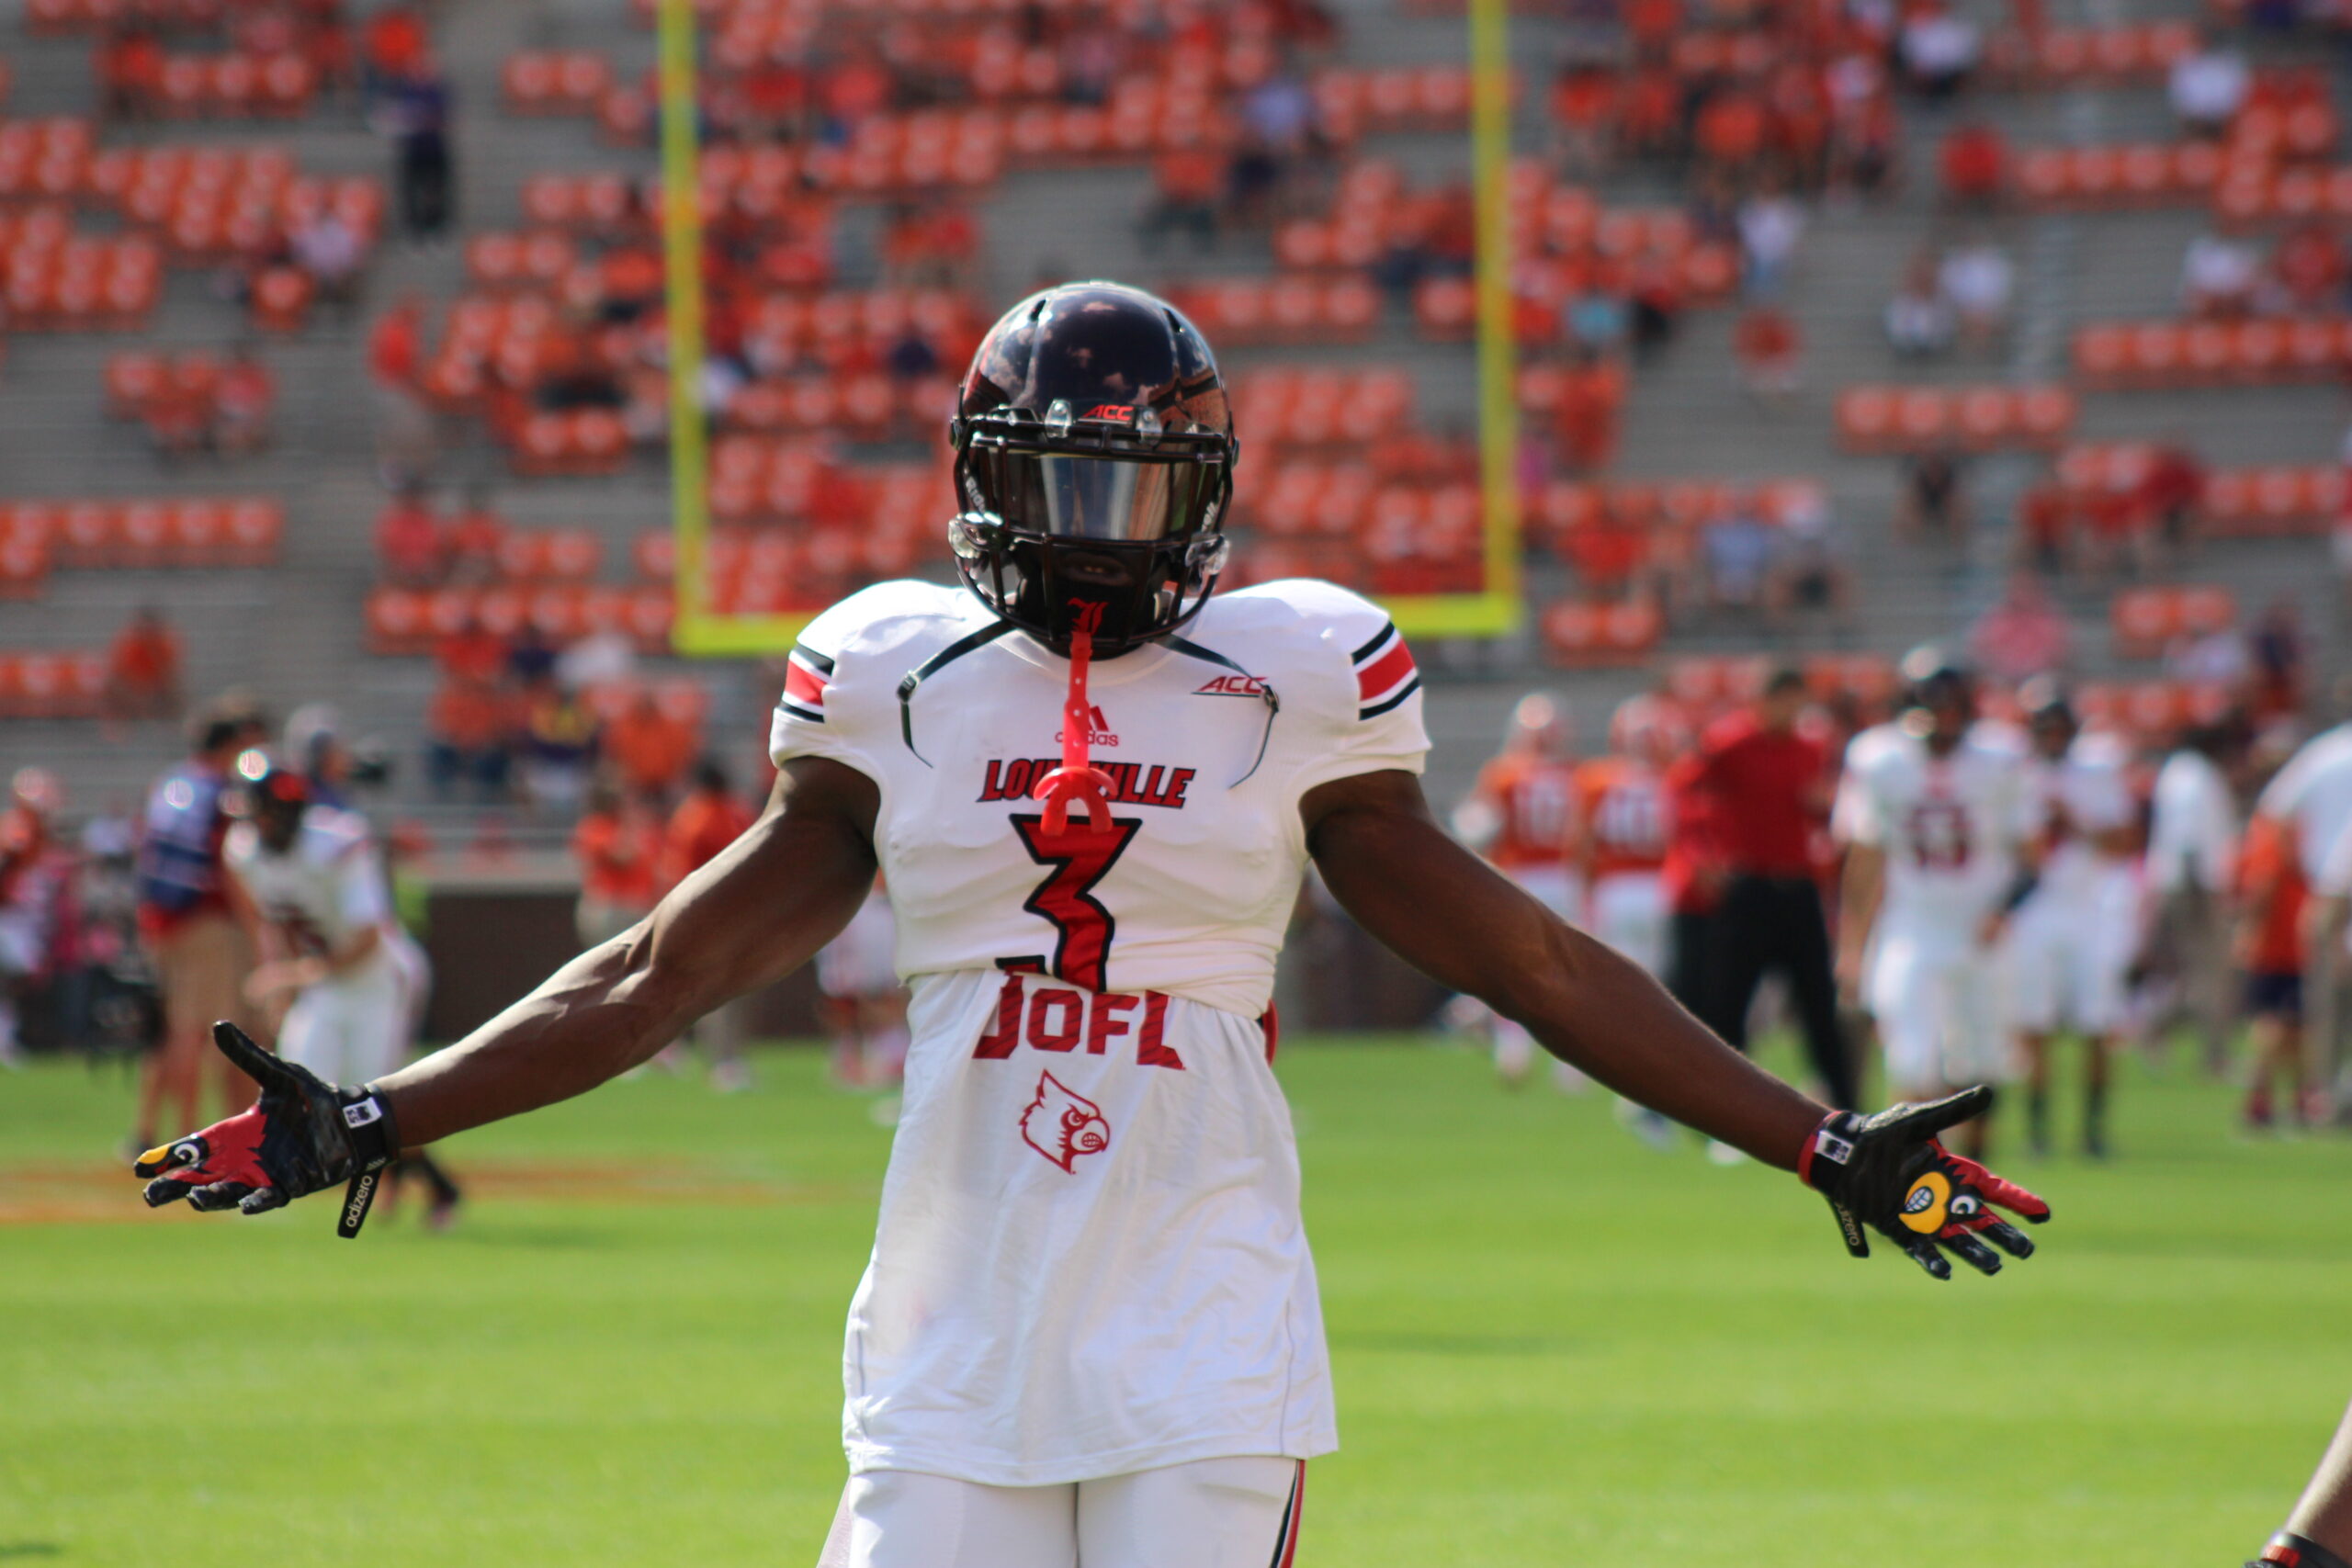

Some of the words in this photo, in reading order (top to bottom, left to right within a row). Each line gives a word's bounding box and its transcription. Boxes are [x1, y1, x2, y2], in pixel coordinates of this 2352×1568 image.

[1082, 404, 1135, 421] ACC
[1197, 676, 1268, 694] ACC
[1055, 730, 1119, 747] adas
[976, 758, 1196, 809] LOUILLE
[995, 813, 1143, 993] 3
[345, 1175, 374, 1228] adizero
[1835, 1201, 1860, 1247] izero
